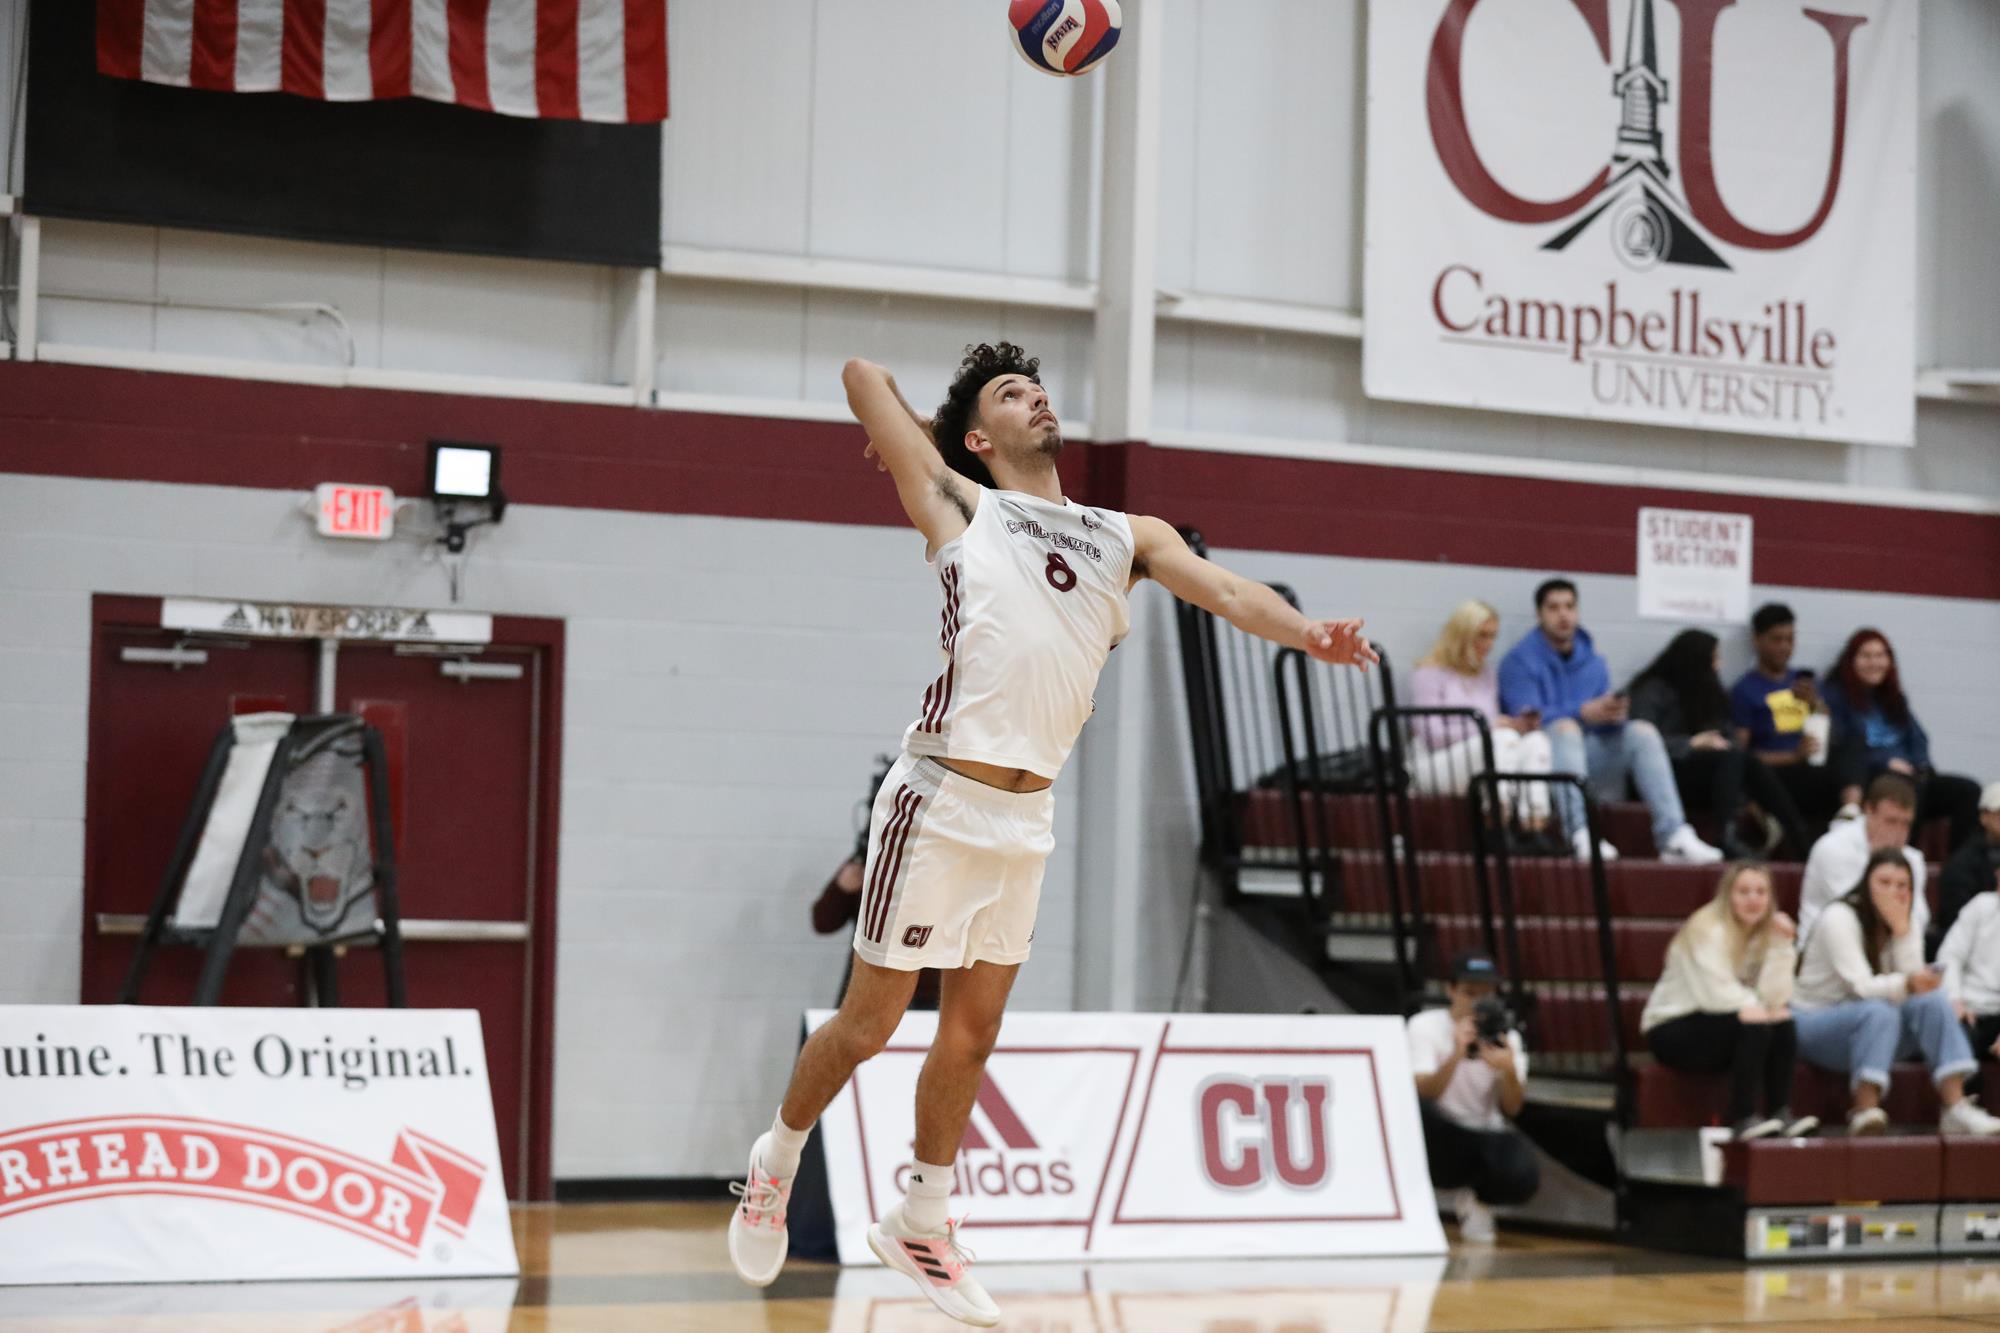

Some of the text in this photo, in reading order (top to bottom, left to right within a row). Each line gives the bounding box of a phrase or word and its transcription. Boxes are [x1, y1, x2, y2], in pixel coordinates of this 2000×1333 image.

[1426, 0, 1868, 253] CU
[1431, 264, 1837, 370] Campbellsville
[1591, 362, 1836, 426] UNIVERSITY
[331, 487, 385, 536] EXIT
[1647, 515, 1744, 542] STUDENT
[1652, 541, 1738, 568] SECTION
[902, 924, 934, 949] CU
[139, 1033, 235, 1078] The
[253, 1034, 473, 1090] Original.
[1196, 1076, 1331, 1189] CU
[243, 1144, 411, 1238] DOOR
